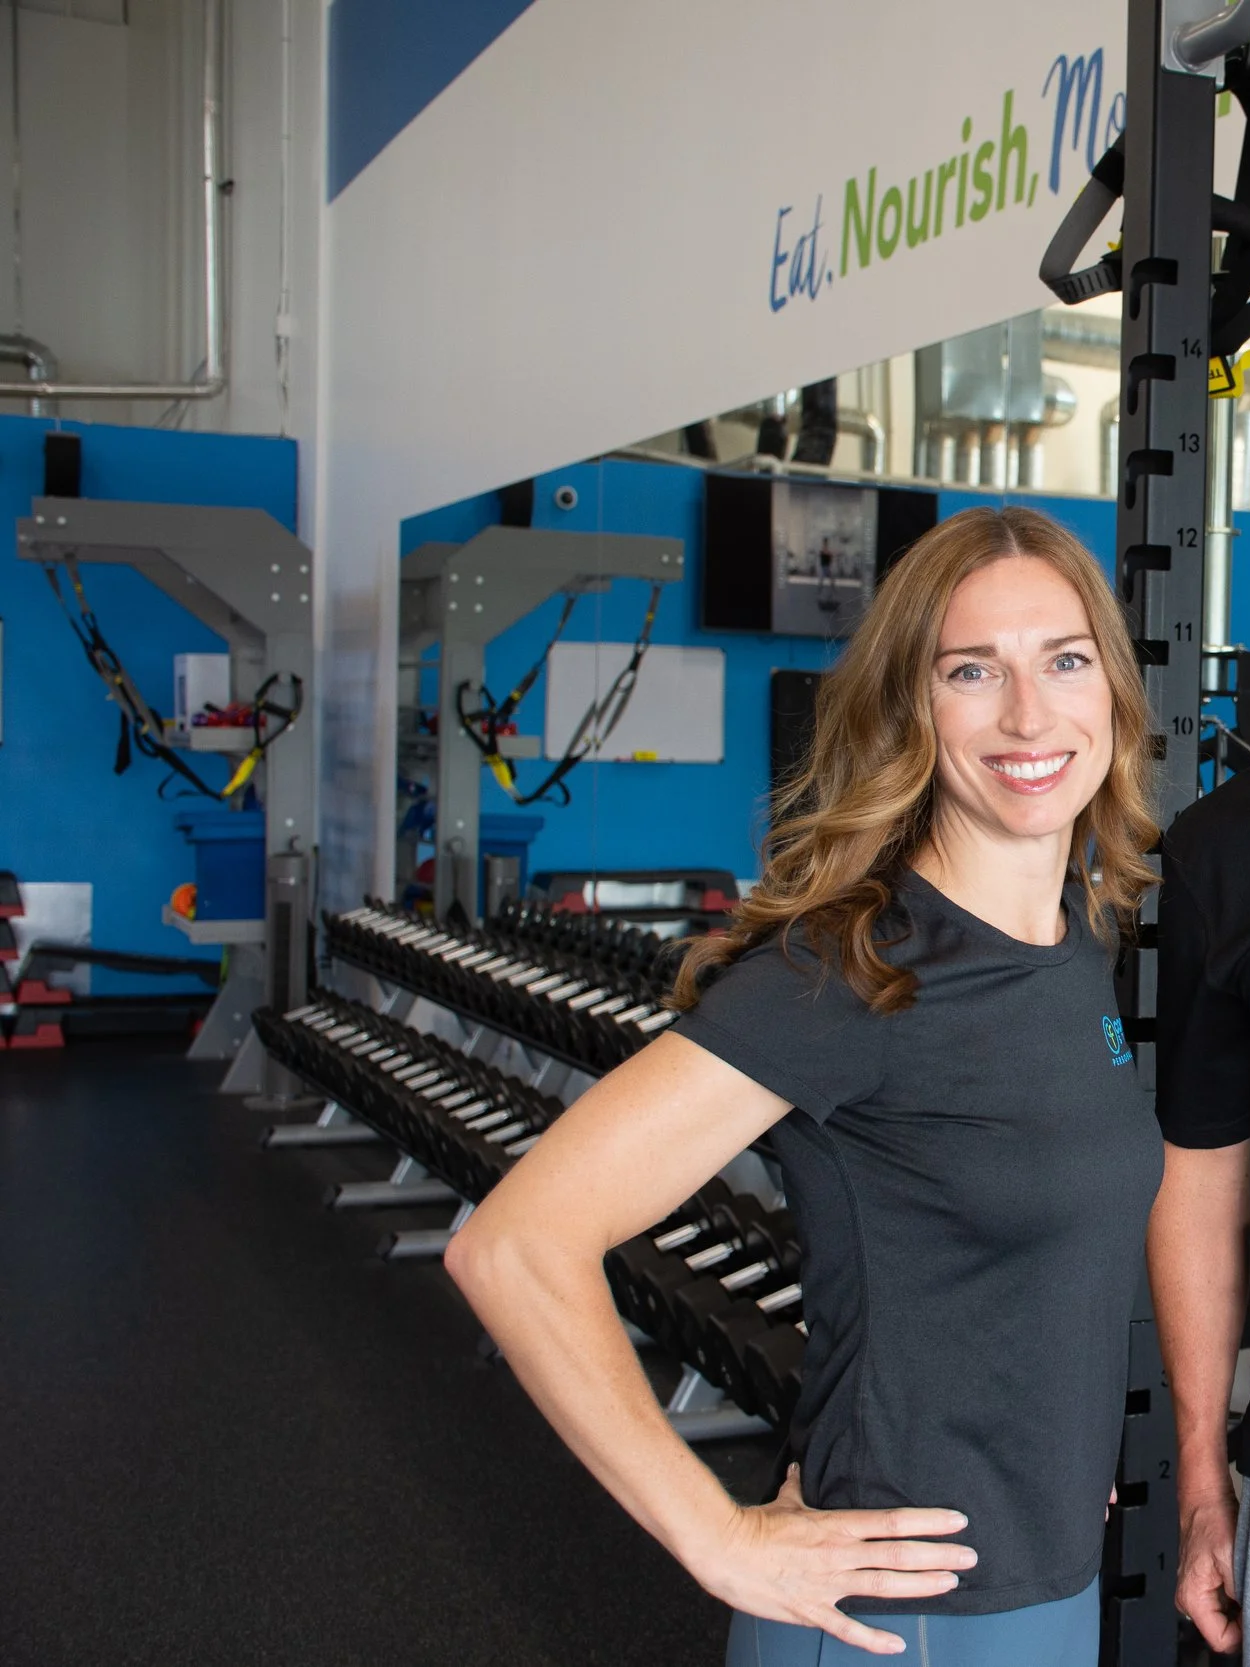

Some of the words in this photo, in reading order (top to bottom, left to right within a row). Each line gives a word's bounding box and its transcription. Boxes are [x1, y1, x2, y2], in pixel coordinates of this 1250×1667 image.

[769, 193, 833, 313] Eat.
[840, 88, 1039, 278] Nourish,
[1181, 337, 1203, 358] 14
[1179, 433, 1200, 453] 13
[1176, 528, 1197, 547] 12
[1174, 622, 1193, 642] 11
[1172, 716, 1194, 735] 10
[1158, 1460, 1170, 1479] 2
[1157, 1552, 1165, 1571] 1
